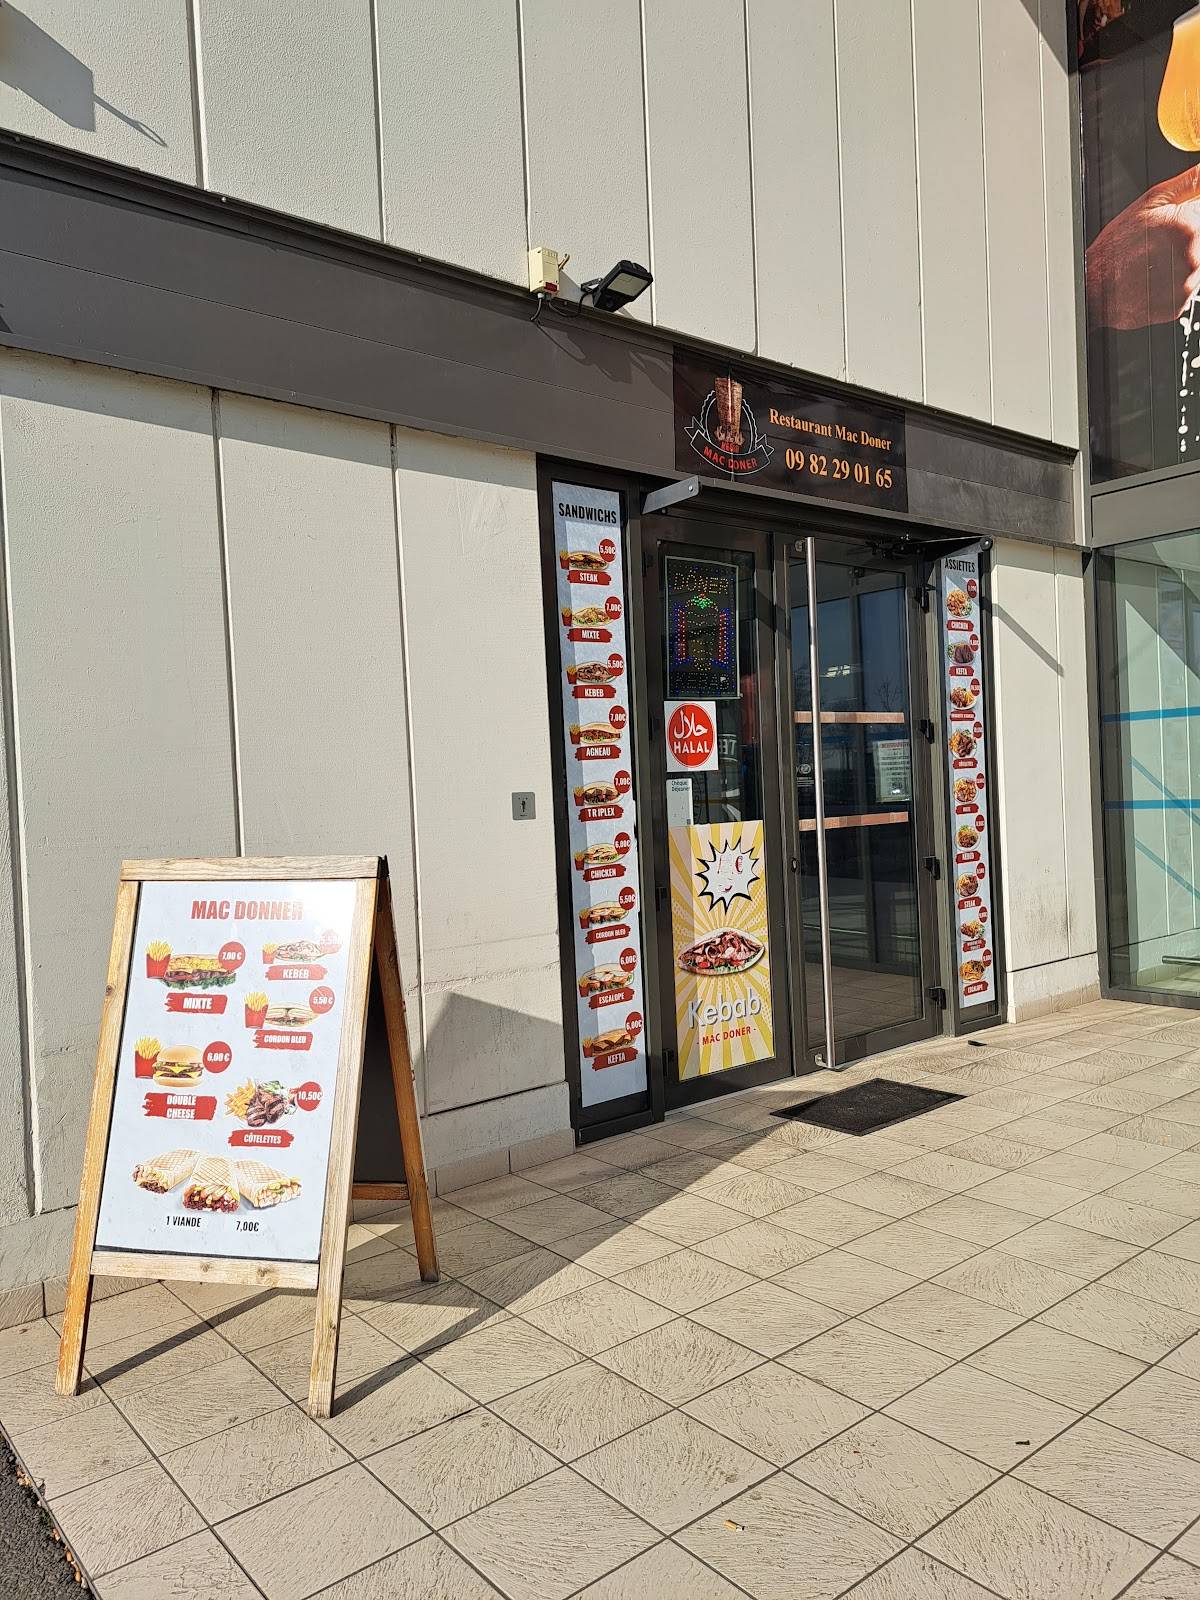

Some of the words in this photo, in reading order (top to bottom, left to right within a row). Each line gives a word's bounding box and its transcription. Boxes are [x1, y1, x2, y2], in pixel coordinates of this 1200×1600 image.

[769, 408, 832, 437] Restaurant
[835, 424, 858, 444] Mac
[861, 431, 892, 450] Doner
[703, 446, 726, 466] MAC
[728, 457, 758, 470] DONER
[786, 448, 804, 470] 09
[809, 453, 828, 477] 82
[832, 458, 850, 480] 29
[854, 463, 870, 485] 01
[875, 468, 892, 489] 65
[558, 502, 617, 524] SANDWICHS
[944, 557, 975, 573] ASSIETTES
[580, 572, 598, 582] STEAK
[581, 630, 600, 639] MIXTE
[674, 708, 708, 739] حلال
[586, 747, 611, 757] AGNEAU
[673, 741, 710, 754] HALAL
[590, 868, 617, 879] CHICKEN
[191, 899, 230, 920] MAC
[234, 899, 305, 921] DONNER
[222, 951, 236, 960] 7,00
[282, 968, 310, 979] KEBEB
[182, 997, 213, 1010] MIXTE
[598, 991, 625, 1005] ESCALOPE
[687, 987, 762, 1030] Kebab
[263, 1035, 290, 1044] CORDON
[291, 1035, 307, 1044] BLEU
[702, 1033, 721, 1046] MAC
[723, 1026, 751, 1041] DONER
[207, 1052, 224, 1062] 6,00
[607, 1052, 626, 1065] KEFTA
[166, 1094, 197, 1106] DOUBLE
[297, 1091, 323, 1102] 10,50€
[166, 1108, 195, 1119] CHEESE
[243, 1133, 282, 1144] CÔTELETTES
[165, 1216, 170, 1226] 1
[172, 1217, 202, 1228] VIANDE
[235, 1221, 260, 1232] 7,00€
